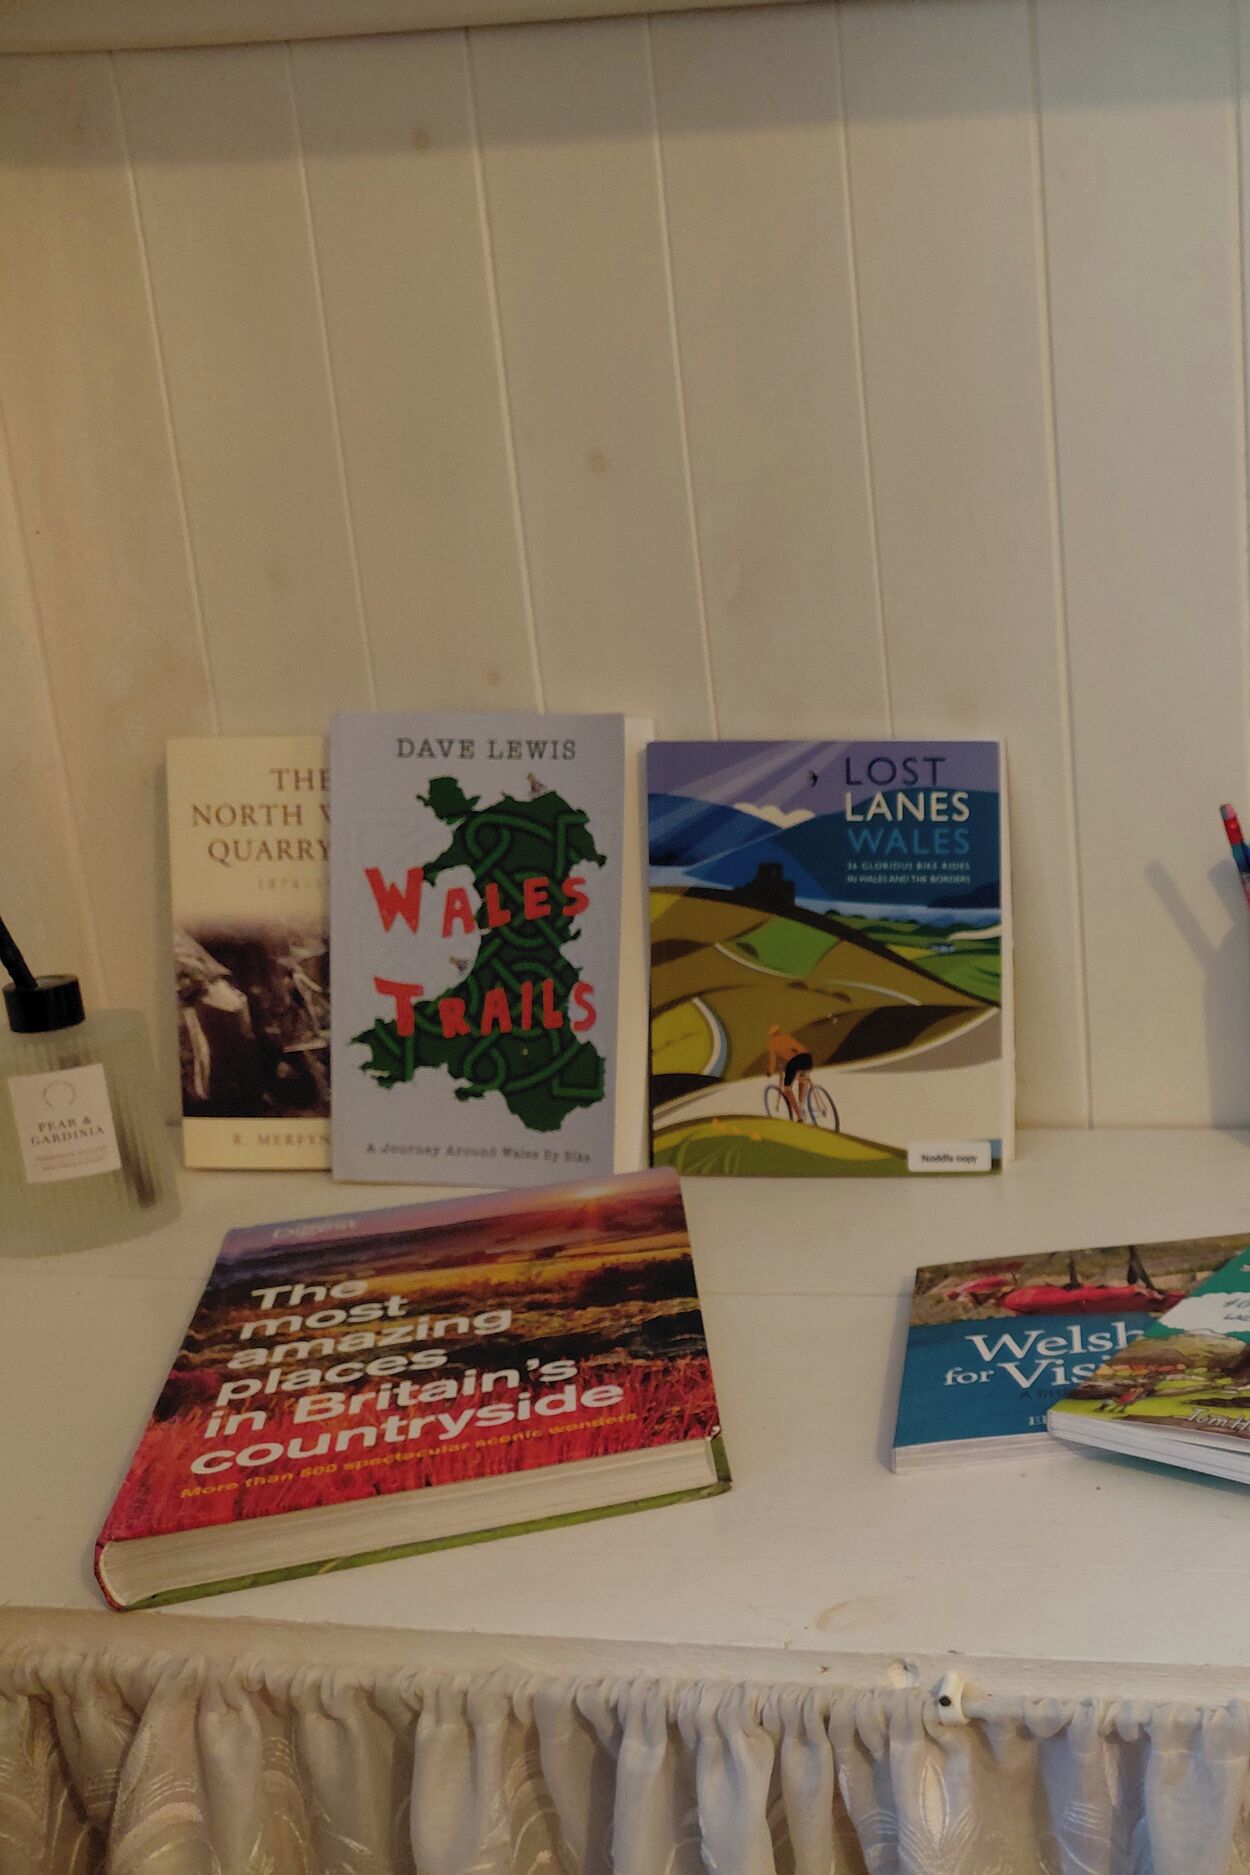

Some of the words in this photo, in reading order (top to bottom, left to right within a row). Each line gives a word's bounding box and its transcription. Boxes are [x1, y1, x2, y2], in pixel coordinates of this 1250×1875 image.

[396, 737, 476, 760] DAVE
[486, 739, 577, 761] LEWIS
[845, 757, 947, 786] LOST
[191, 803, 303, 828] NORTH
[845, 791, 970, 822] LANES
[847, 827, 970, 855] WALES
[859, 875, 885, 884] WALES
[888, 875, 910, 884] AND
[911, 875, 927, 884] THE
[930, 875, 970, 884] BORDERS
[861, 862, 913, 871] GLORIOUS
[916, 862, 938, 871] BIKE
[941, 862, 970, 871] RIDES
[365, 867, 590, 937] WALES
[374, 976, 597, 1038] TRAILS
[82, 1116, 92, 1125] &
[367, 1142, 376, 1154] A
[381, 1143, 441, 1158] Journey
[446, 1145, 497, 1158] Around
[502, 1147, 539, 1160] Wales
[563, 1150, 592, 1163] Bike
[957, 1154, 977, 1164] copy
[251, 1279, 368, 1311] The
[240, 1295, 409, 1341] most
[227, 1309, 512, 1369] amazing
[965, 1320, 1145, 1362] Welsh
[215, 1348, 449, 1407] places
[943, 1366, 995, 1386] for
[997, 1354, 1111, 1389] Vis
[204, 1410, 267, 1438] in
[293, 1357, 578, 1424] Britain's
[190, 1384, 625, 1475] countryside
[1187, 1408, 1228, 1428] Tom
[180, 1481, 238, 1498] More
[245, 1471, 294, 1488] than
[343, 1441, 470, 1470] spectacular
[475, 1429, 542, 1449] scenic
[549, 1412, 637, 1434] wonders
